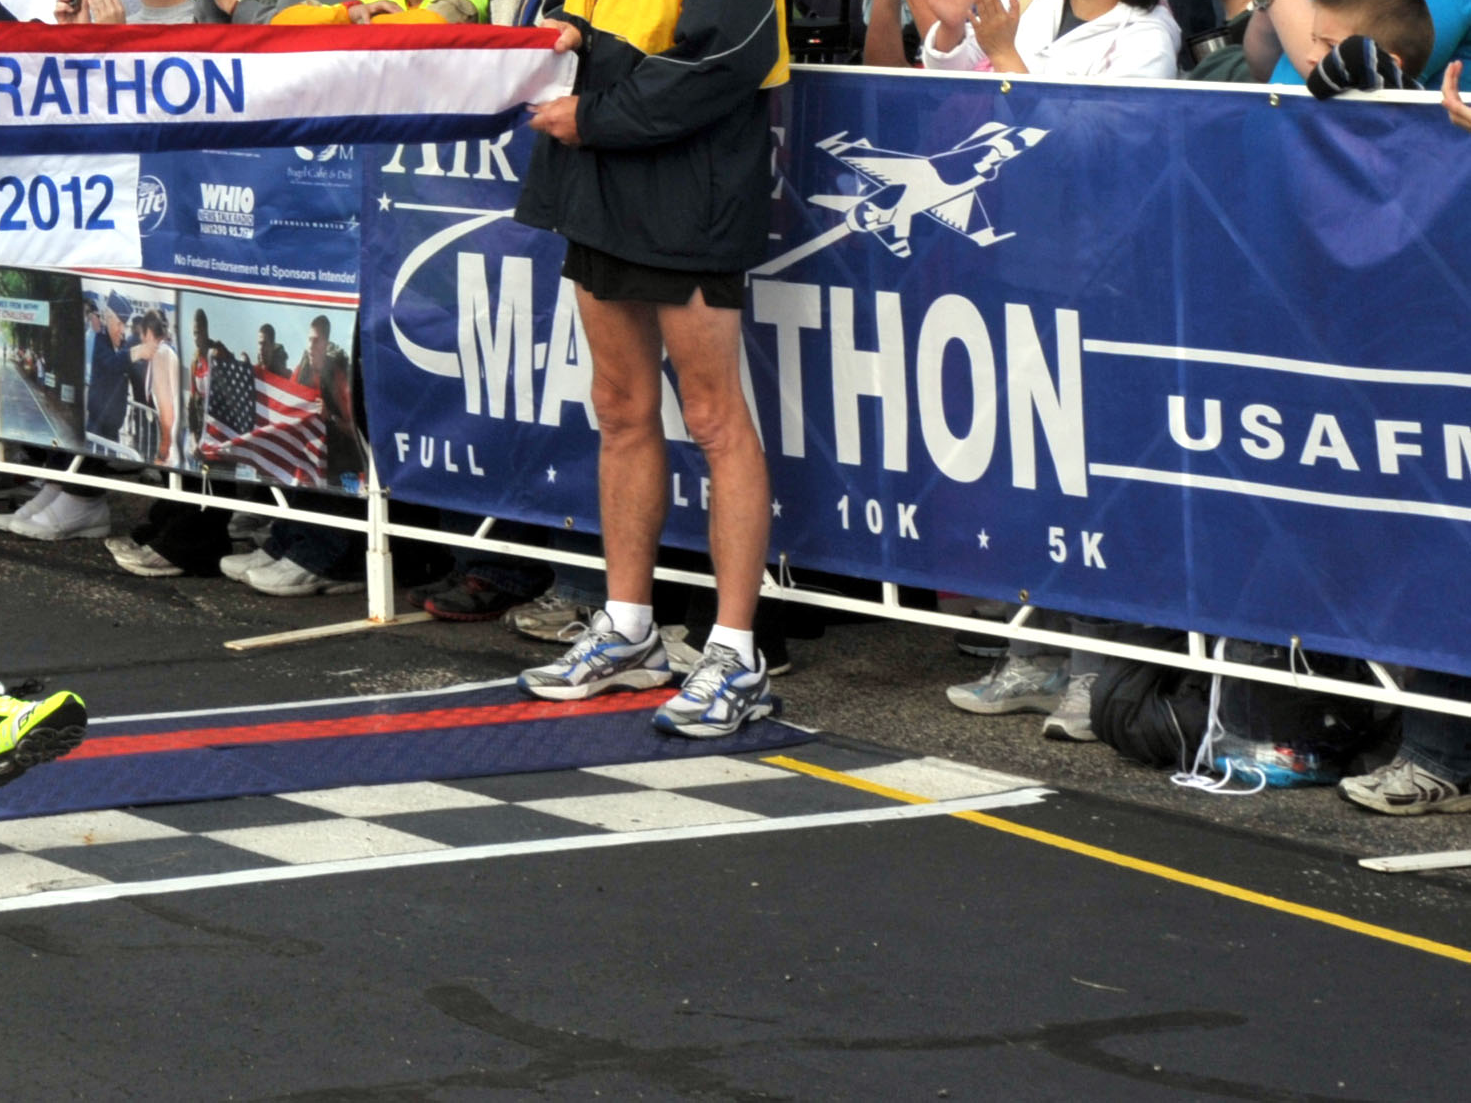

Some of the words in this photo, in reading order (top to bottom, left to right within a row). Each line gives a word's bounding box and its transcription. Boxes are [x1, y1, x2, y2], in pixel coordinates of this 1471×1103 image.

[200, 182, 254, 214] WHIO
[211, 258, 259, 276] Endorsement
[260, 264, 270, 277] of
[271, 265, 317, 280] Sponsors
[318, 269, 356, 284] Intended
[457, 251, 1089, 498] MATHON
[394, 432, 486, 477] FULL
[836, 495, 920, 541] 10K
[1047, 526, 1107, 570] 5K
